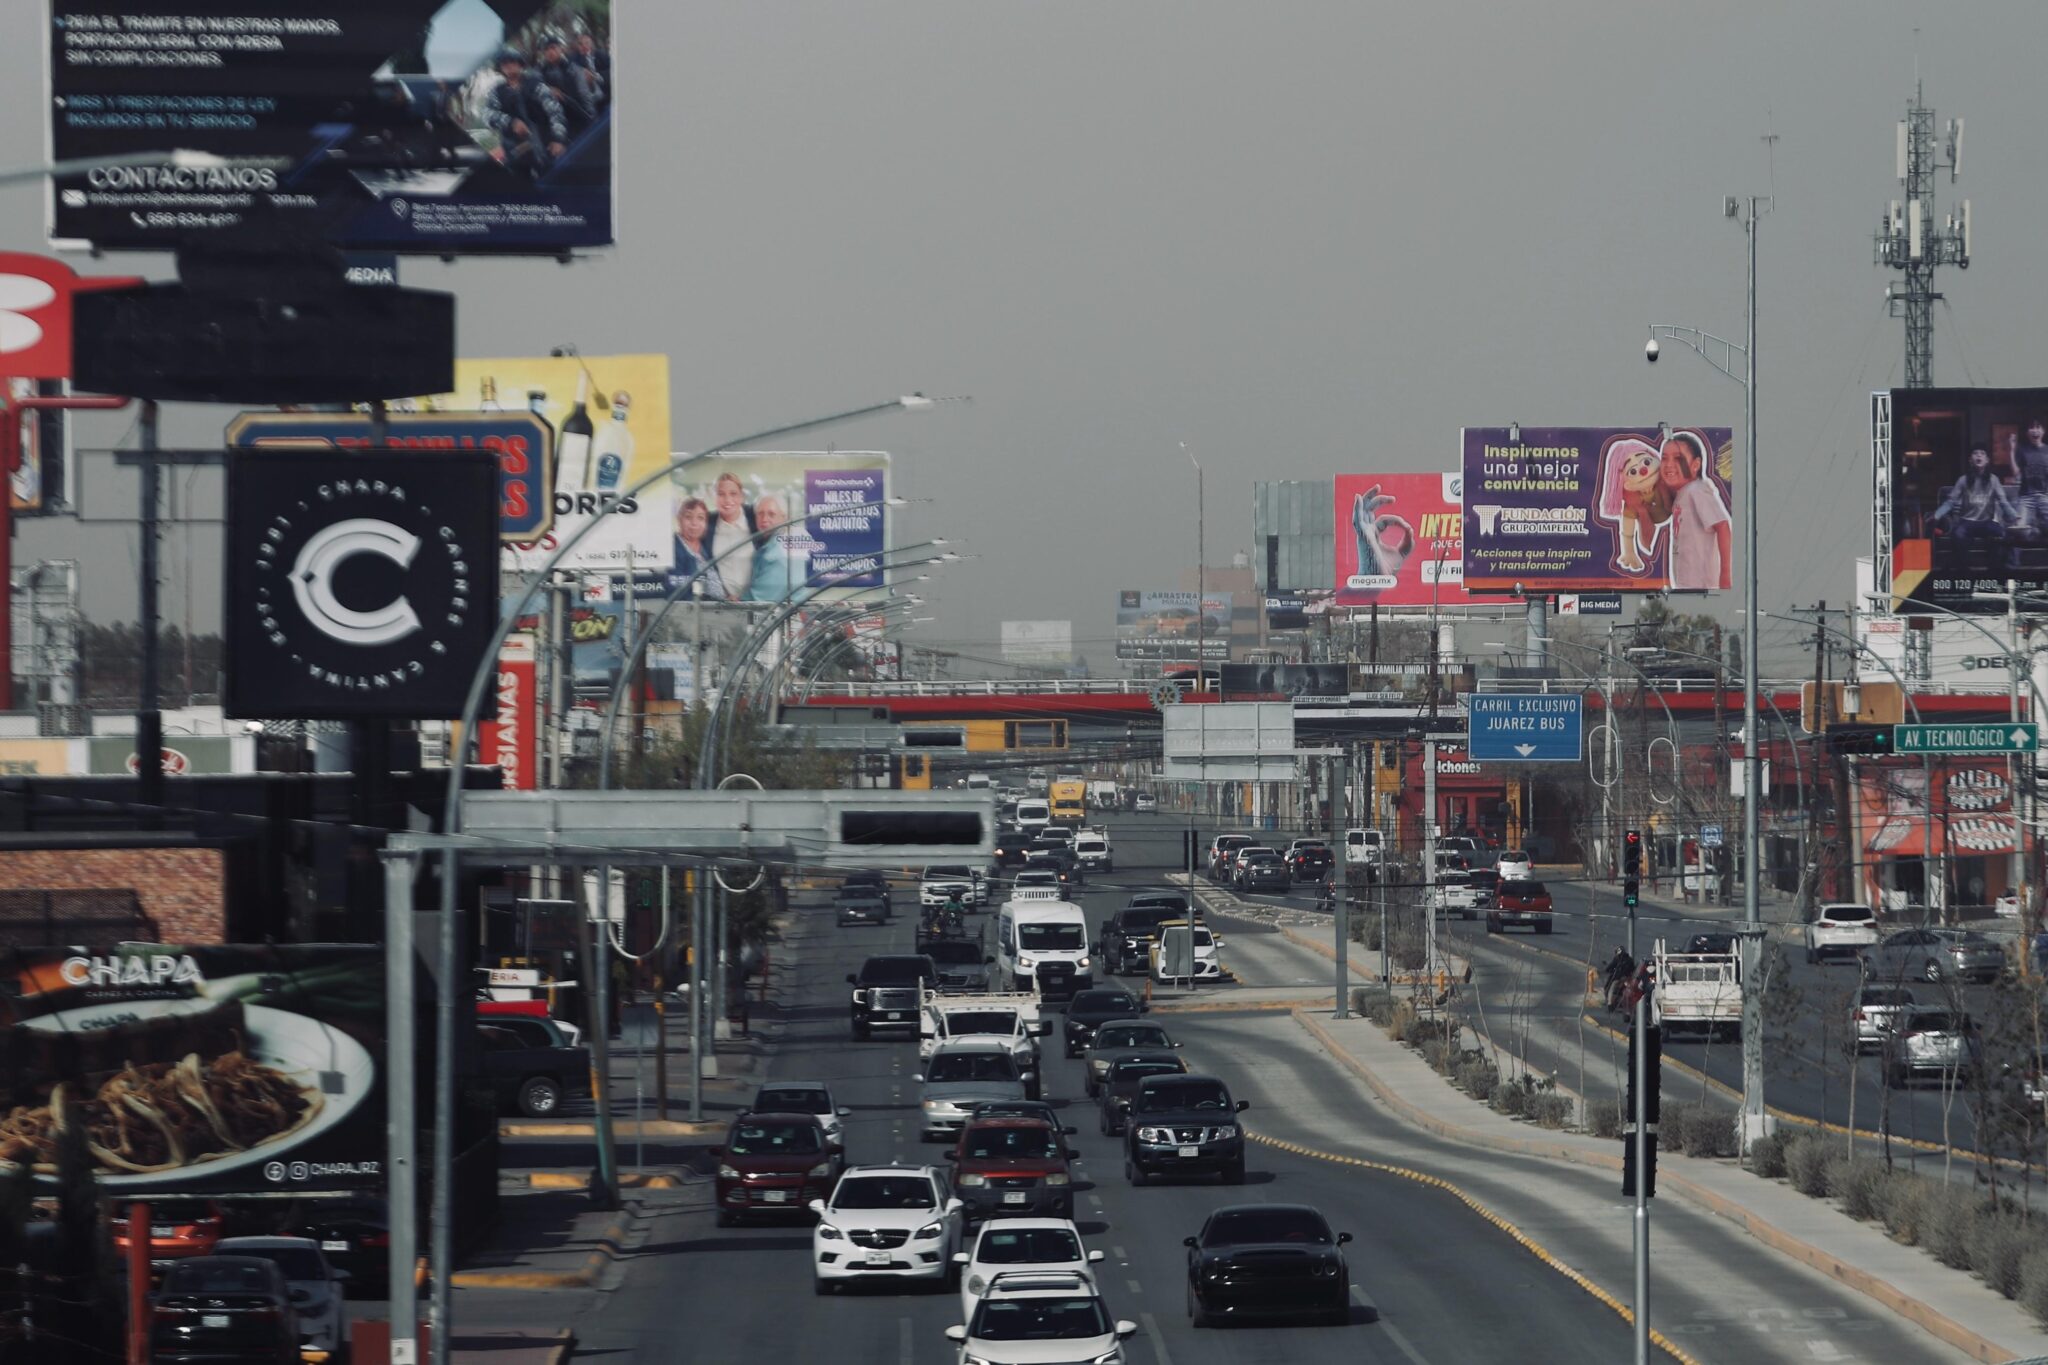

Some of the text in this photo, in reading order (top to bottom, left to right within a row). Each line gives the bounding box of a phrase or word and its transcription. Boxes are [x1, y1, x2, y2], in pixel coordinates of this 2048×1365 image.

[1485, 444, 1579, 461] Inspiramos
[1484, 460, 1579, 479] una mejor
[1484, 477, 1579, 490] convivencia
[824, 490, 864, 504] MILES DE
[1501, 505, 1586, 521] FUNDACIÓN
[819, 517, 870, 532] GRATUITOS
[1501, 523, 1584, 533] GRUPO IMPERIAL
[783, 541, 825, 552] conmigo
[1525, 551, 1546, 560] que
[1548, 548, 1592, 561] inspiran
[1490, 562, 1498, 572] y
[1352, 578, 1392, 586] mega.mx
[1933, 579, 1951, 590] 800
[1955, 579, 1971, 590] 120
[1580, 600, 1620, 610] BIG MEDIA
[1360, 665, 1373, 675] UNA
[1375, 665, 1402, 675] FAMILIA
[1404, 665, 1425, 675] UNIDA
[1447, 665, 1464, 675] VIDA
[1475, 699, 1576, 712] CARRIL EXCLUSIVO
[1487, 717, 1565, 730] JUAREZ BUS
[1904, 726, 2004, 747] AV. TECNOLÓGICO
[60, 954, 204, 986] CHAPA
